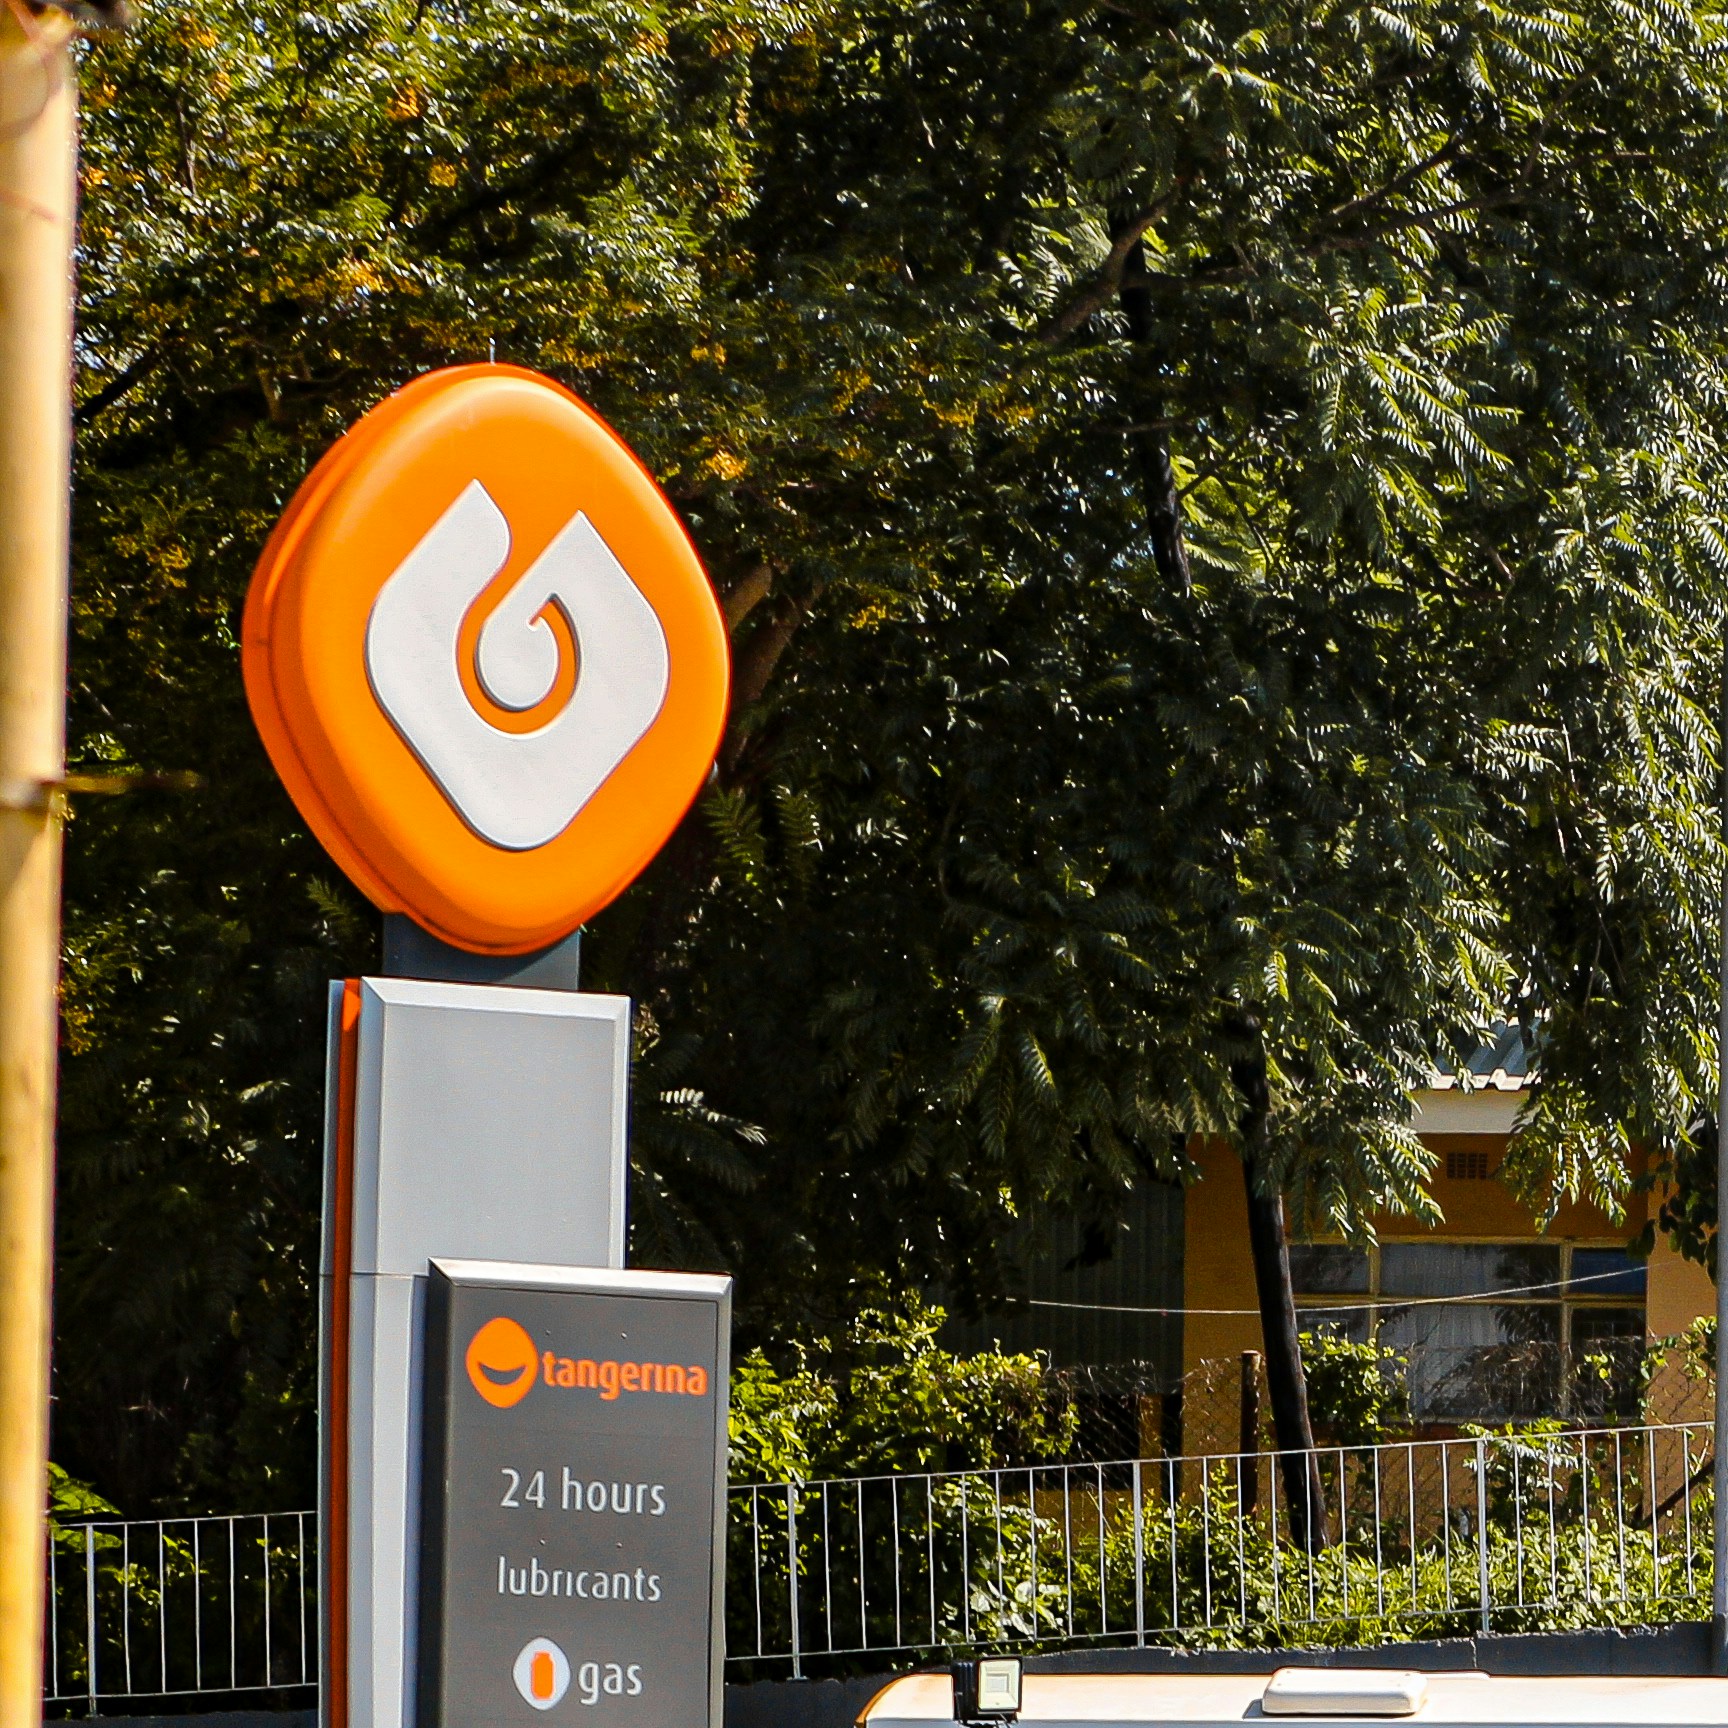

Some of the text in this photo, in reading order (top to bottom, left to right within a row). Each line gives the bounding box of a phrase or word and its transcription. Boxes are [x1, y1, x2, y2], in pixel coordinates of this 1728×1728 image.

[542, 1351, 708, 1401] tangerina
[500, 1465, 667, 1517] 24 hours
[497, 1555, 662, 1602] lubricants
[578, 1662, 643, 1706] gas
